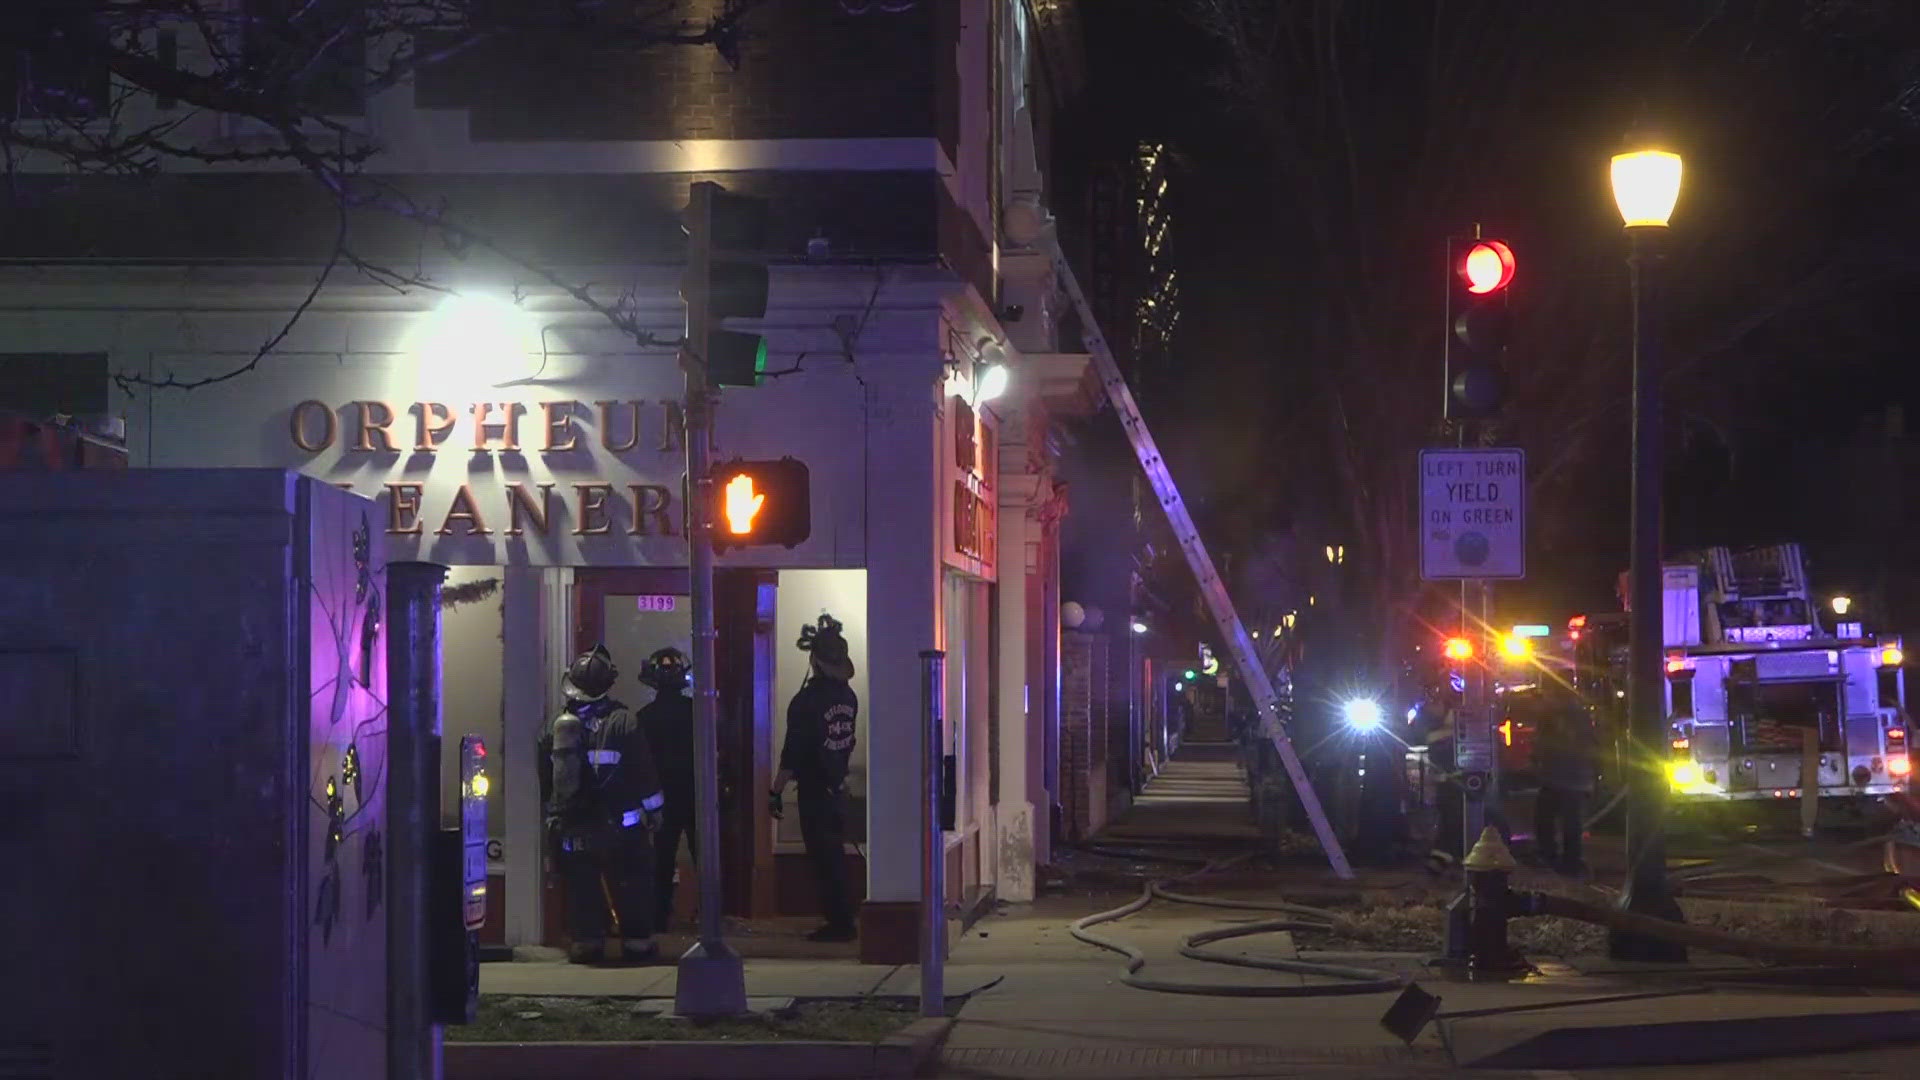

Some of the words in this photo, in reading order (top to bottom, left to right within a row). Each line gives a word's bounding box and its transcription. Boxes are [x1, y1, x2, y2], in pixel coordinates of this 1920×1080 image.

[1427, 461, 1463, 477] LEFT
[1476, 460, 1517, 476] TURN
[1446, 483, 1499, 502] YIELD
[333, 482, 680, 536] EANER
[1431, 510, 1451, 525] ON
[1463, 509, 1513, 525] GREEN
[639, 596, 673, 610] 3199
